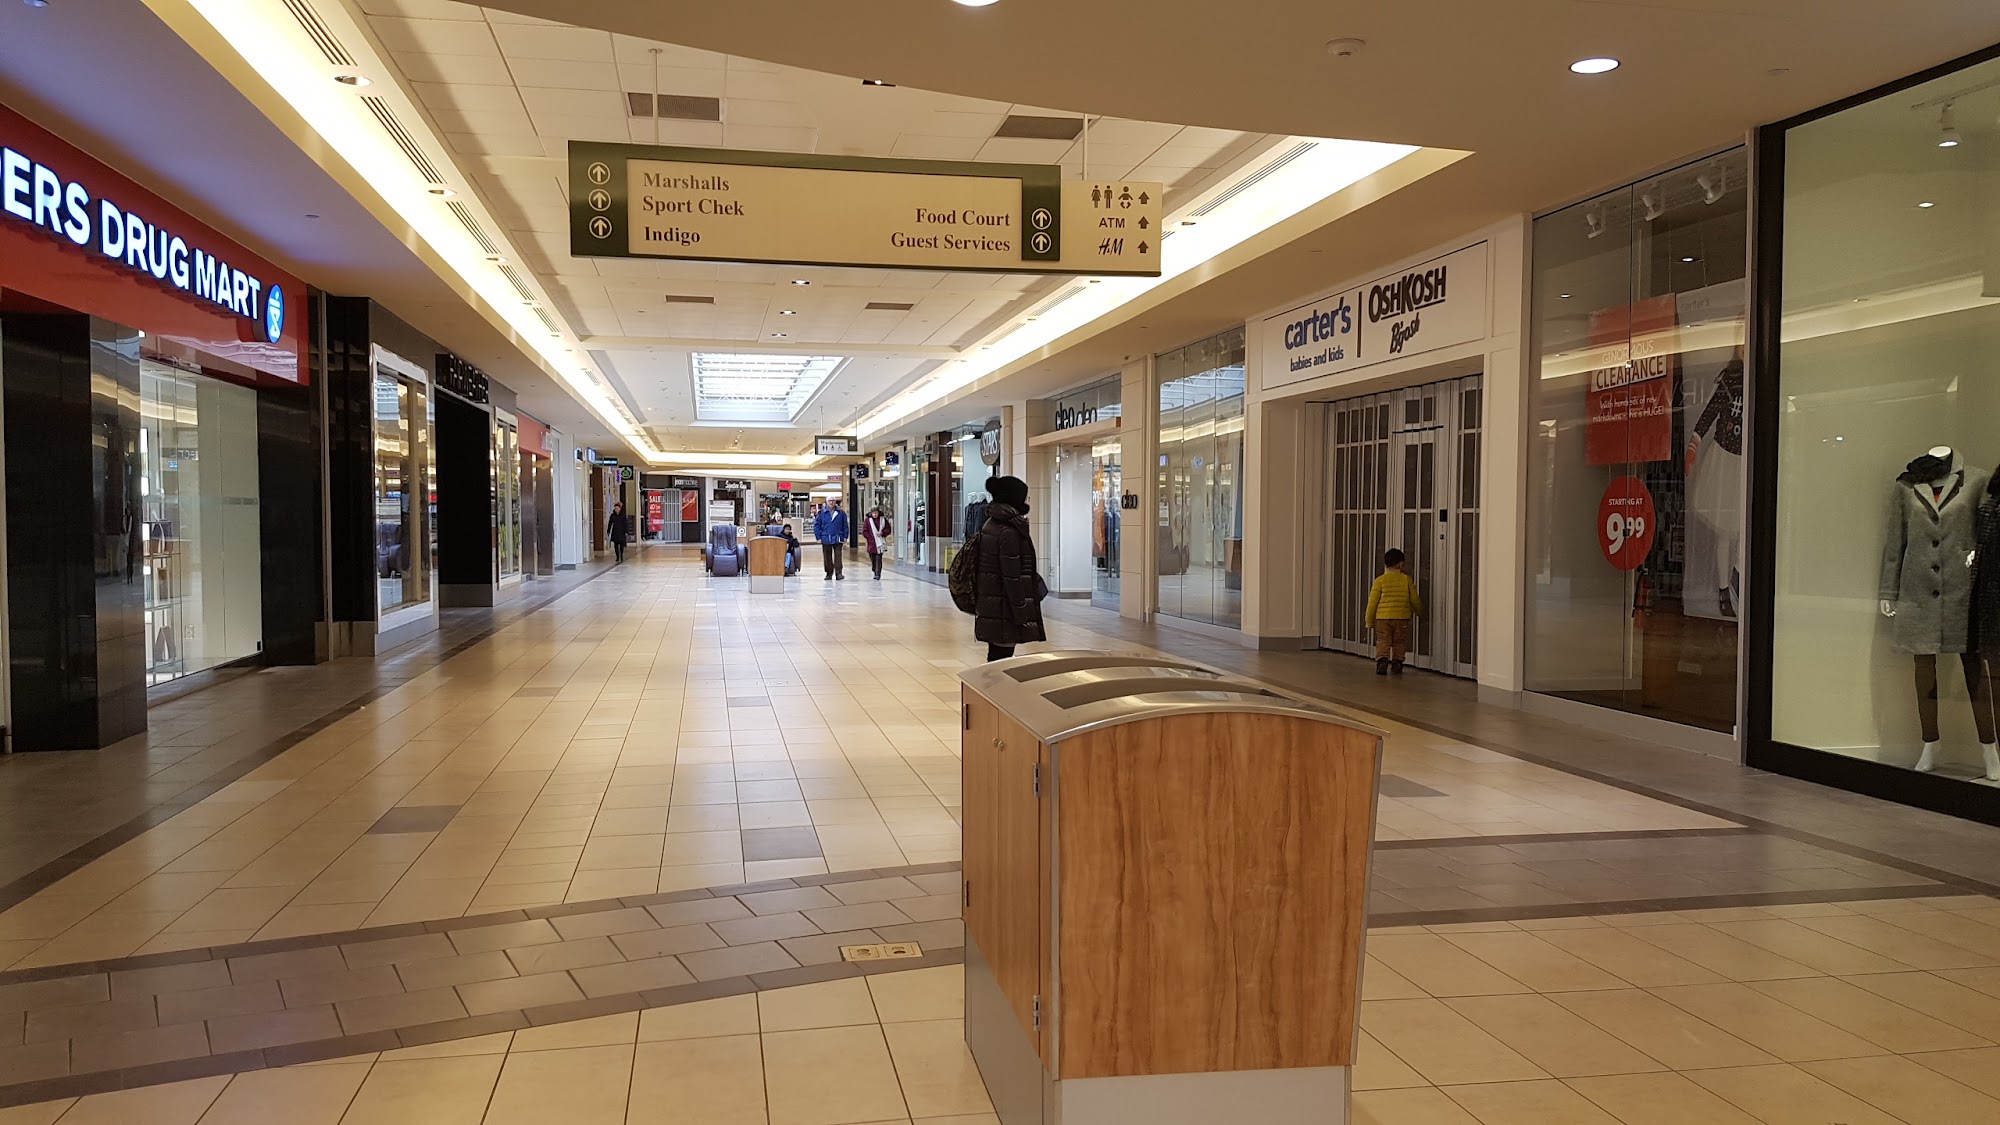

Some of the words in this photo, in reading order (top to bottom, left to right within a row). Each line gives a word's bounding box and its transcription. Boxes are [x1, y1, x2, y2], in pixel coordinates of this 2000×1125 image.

[643, 172, 730, 191] Marshalls
[643, 195, 693, 216] Sport
[698, 198, 745, 216] Chek
[916, 207, 957, 225] Food
[962, 209, 1011, 227] Court
[1098, 217, 1126, 229] ATM
[0, 147, 91, 245] ERS
[101, 199, 190, 290] DRUG
[195, 248, 261, 320] MART
[644, 226, 701, 247] Indigo
[891, 231, 940, 249] Guest
[943, 234, 1011, 252] Services
[1098, 237, 1124, 256] H&M
[1284, 296, 1352, 350] carter's
[1290, 353, 1312, 372] babies
[1313, 350, 1327, 366] and
[1328, 345, 1344, 363] kids
[1614, 396, 1638, 408] hundeds
[1055, 402, 1074, 431] cleo
[1121, 489, 1138, 509] cleo
[1608, 498, 1635, 506] STARTING
[1635, 497, 1643, 505] AT
